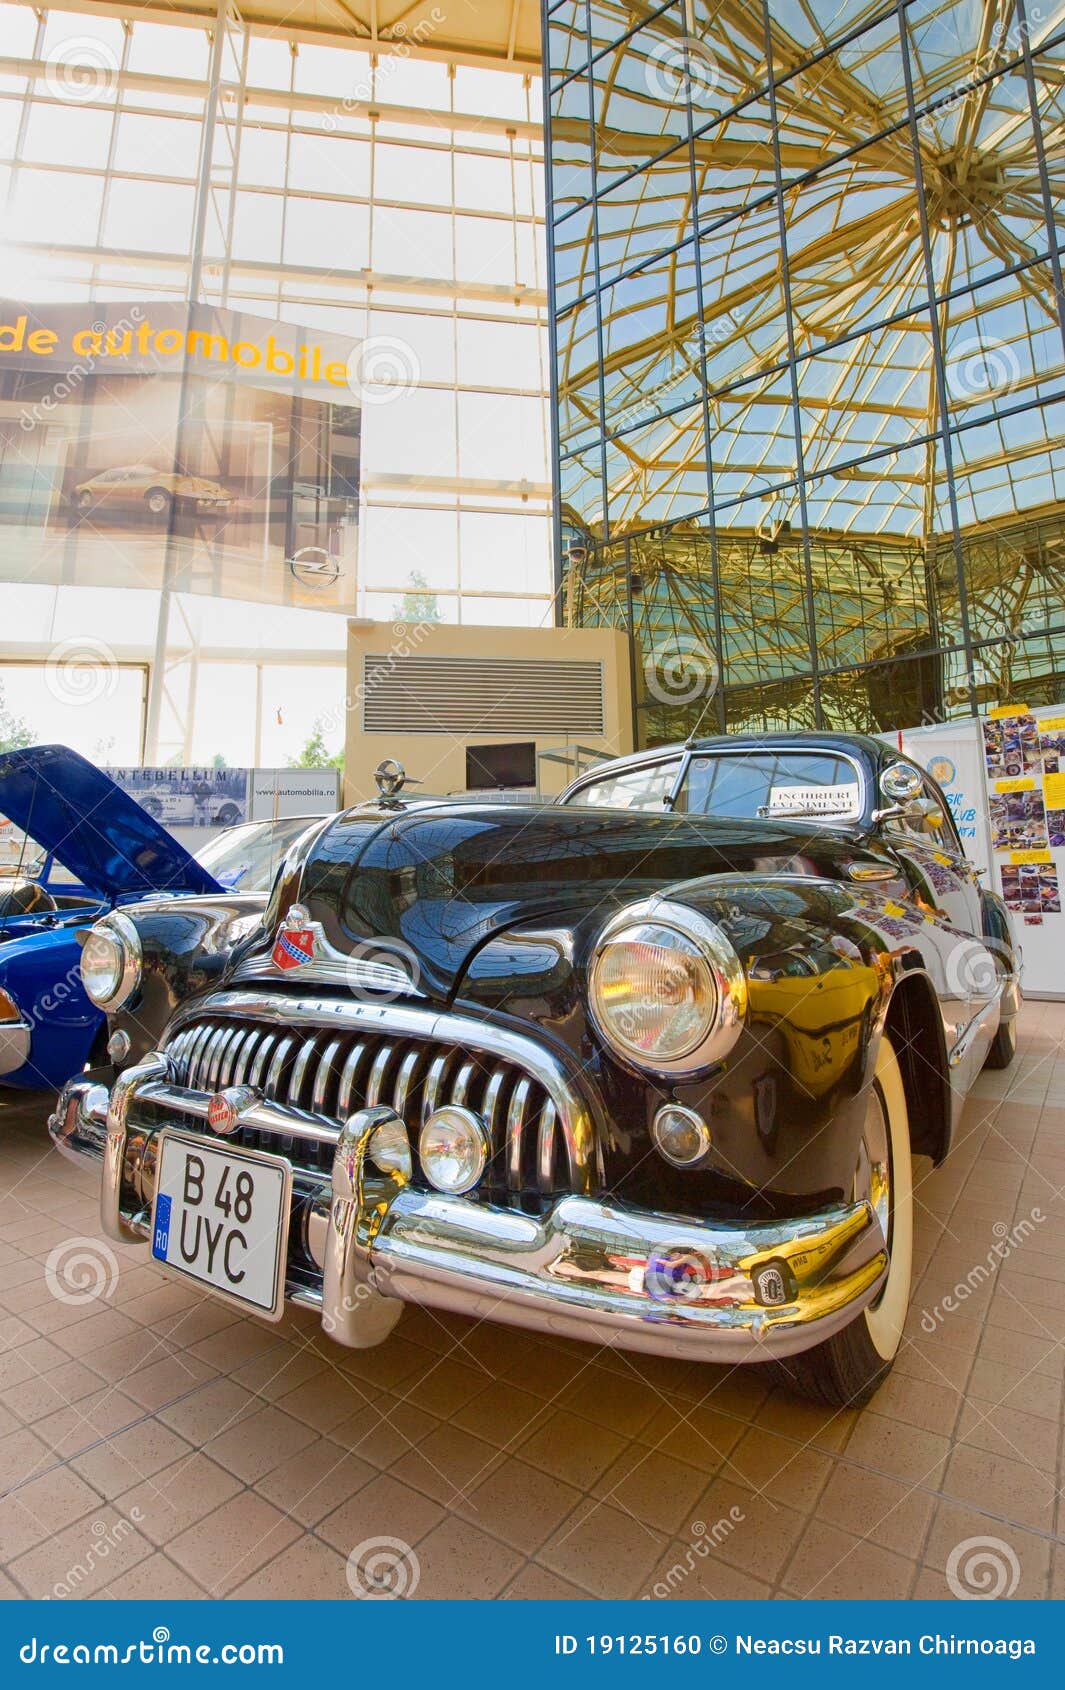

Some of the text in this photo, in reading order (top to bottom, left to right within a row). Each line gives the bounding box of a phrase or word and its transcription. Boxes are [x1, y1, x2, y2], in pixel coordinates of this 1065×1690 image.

[0, 316, 350, 387] de automobile
[255, 787, 336, 798] www.automobilia.ro
[945, 792, 965, 806] SIC
[953, 808, 977, 821] LUB
[183, 1153, 254, 1224] B 48
[155, 1229, 169, 1252] RO
[180, 1209, 249, 1284] UYC
